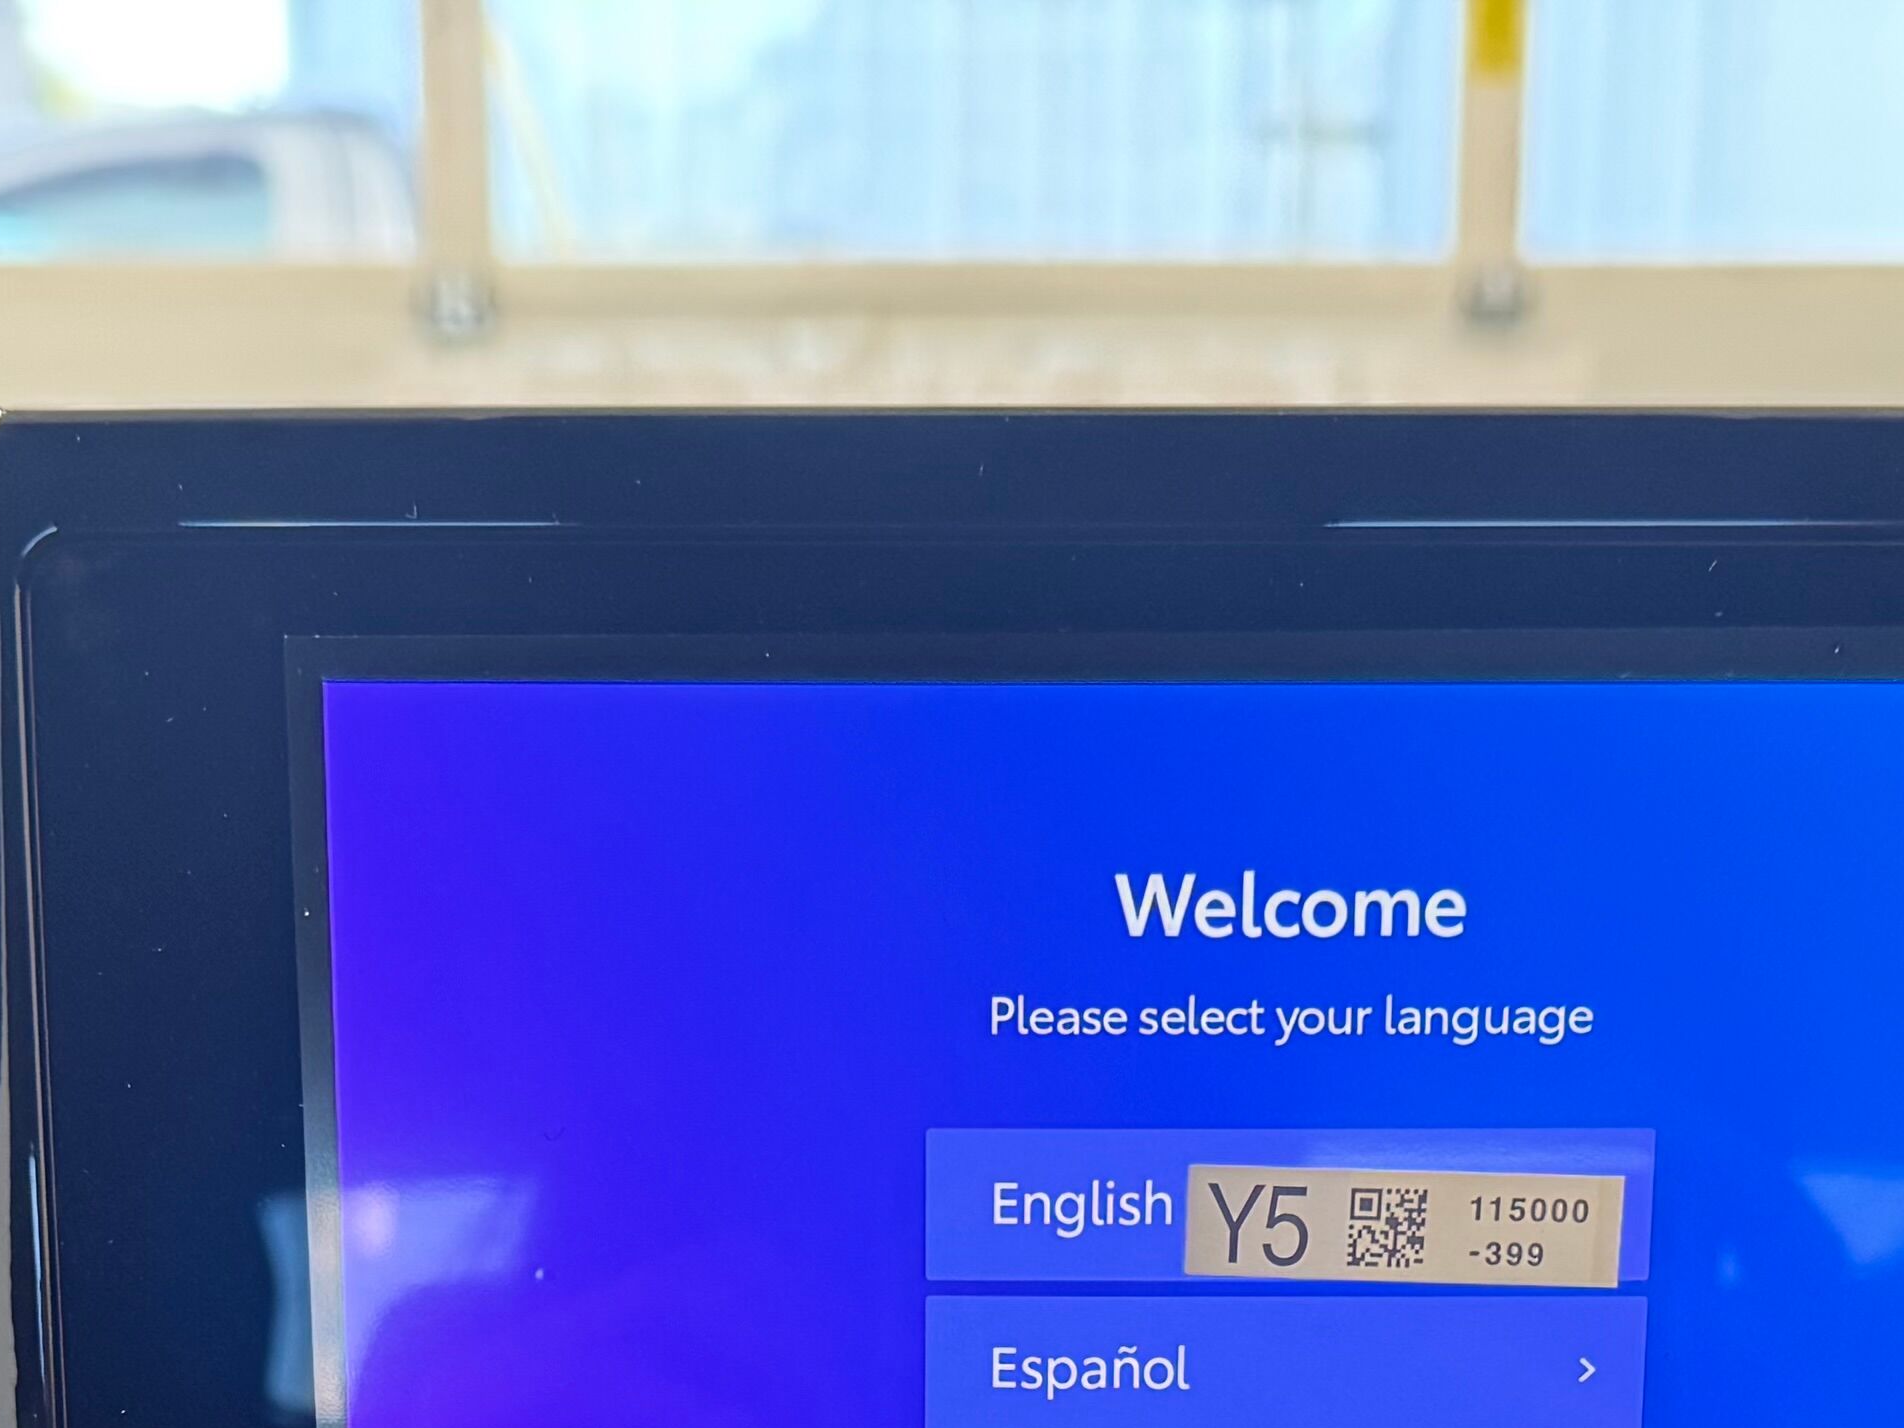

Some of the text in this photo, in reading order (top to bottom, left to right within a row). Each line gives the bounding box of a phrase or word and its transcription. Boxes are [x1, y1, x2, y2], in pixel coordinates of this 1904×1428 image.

[1114, 869, 1468, 938] Welcome
[990, 994, 1594, 1046] Please select your language
[992, 1180, 1174, 1237] English
[1207, 1182, 1310, 1267] Y5
[1469, 1195, 1591, 1225] 115000
[1468, 1241, 1545, 1268] -399
[991, 1345, 1191, 1400] Español
